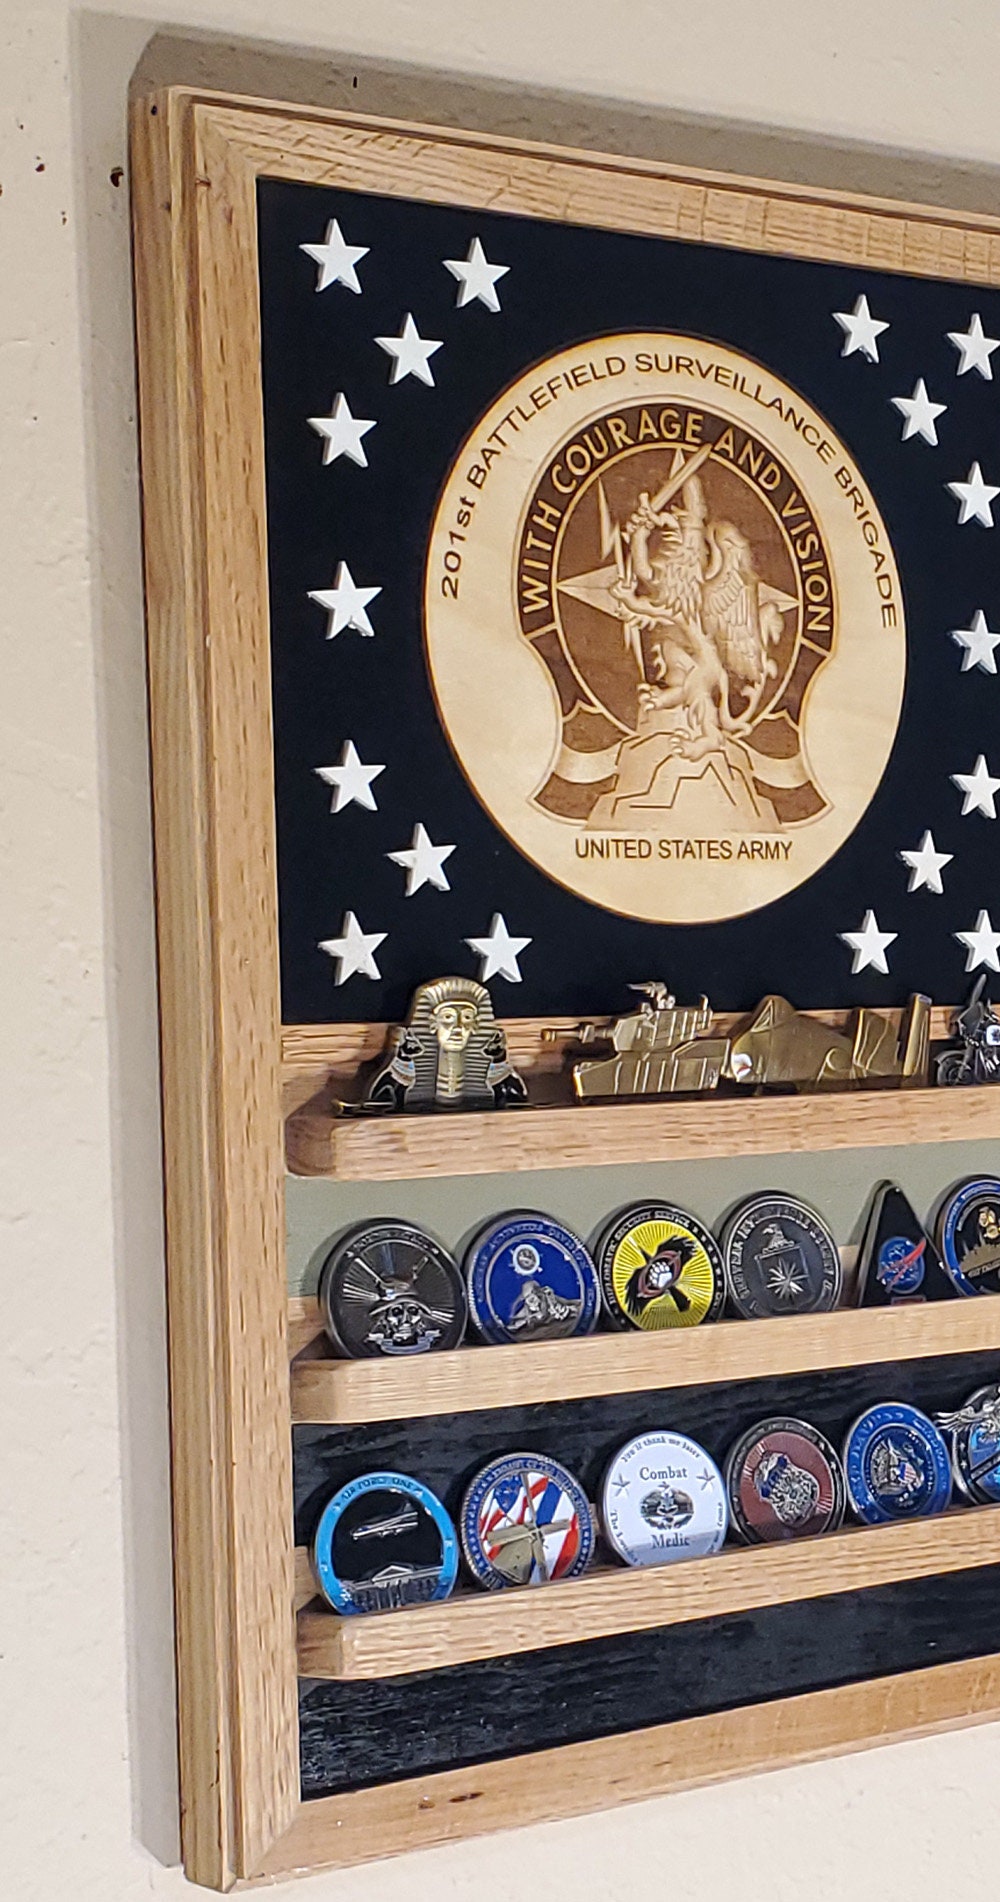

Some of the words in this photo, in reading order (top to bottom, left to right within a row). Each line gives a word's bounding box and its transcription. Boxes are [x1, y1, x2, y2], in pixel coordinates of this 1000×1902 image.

[440, 495, 477, 600] 201st
[467, 356, 627, 489] BATTLEFIELD
[633, 352, 837, 465] SURVEILLANCE
[833, 464, 898, 630] BRIGADE
[521, 500, 562, 616] WITH
[551, 409, 704, 494] COURAGE
[715, 428, 783, 492] AND
[781, 491, 832, 632] VISION
[574, 837, 653, 860] UNITED
[657, 838, 733, 861] STATES
[737, 838, 793, 862] ARMY
[639, 1465, 688, 1481] Combat
[650, 1532, 691, 1550] Medic
